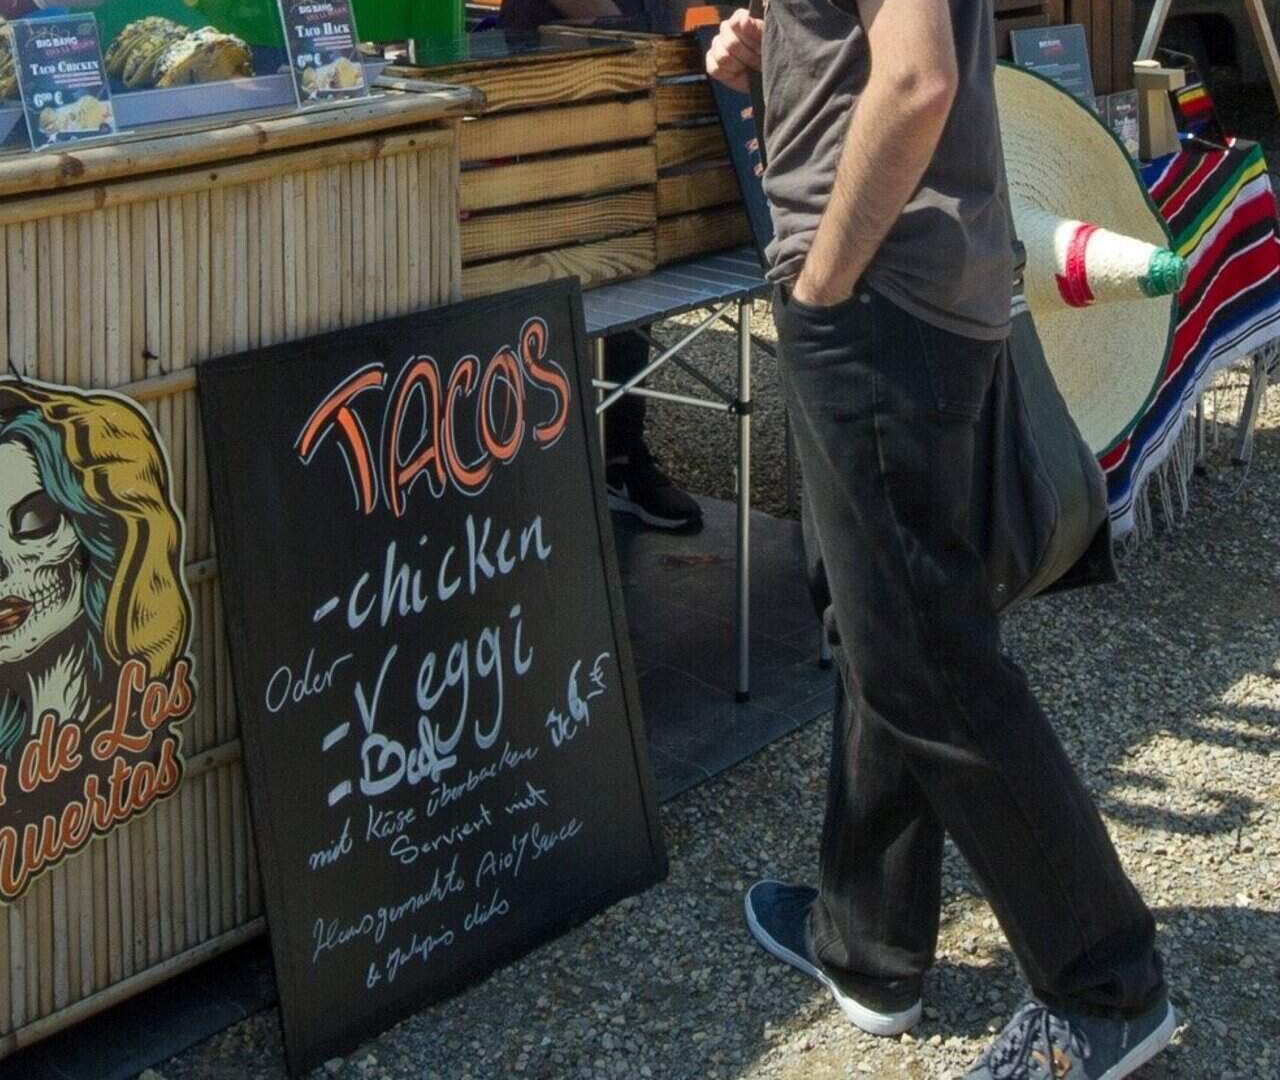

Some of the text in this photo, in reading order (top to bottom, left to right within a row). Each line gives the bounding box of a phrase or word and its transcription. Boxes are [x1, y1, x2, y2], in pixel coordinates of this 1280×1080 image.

[299, 3, 333, 14] BIG BANG
[36, 37, 78, 49] BIG BANG
[294, 316, 571, 518] TACOS
[265, 648, 353, 714] Oder
[20, 713, 83, 794] de
[91, 658, 195, 758] Los
[309, 816, 353, 870] mit
[390, 781, 549, 864] Serviert mit
